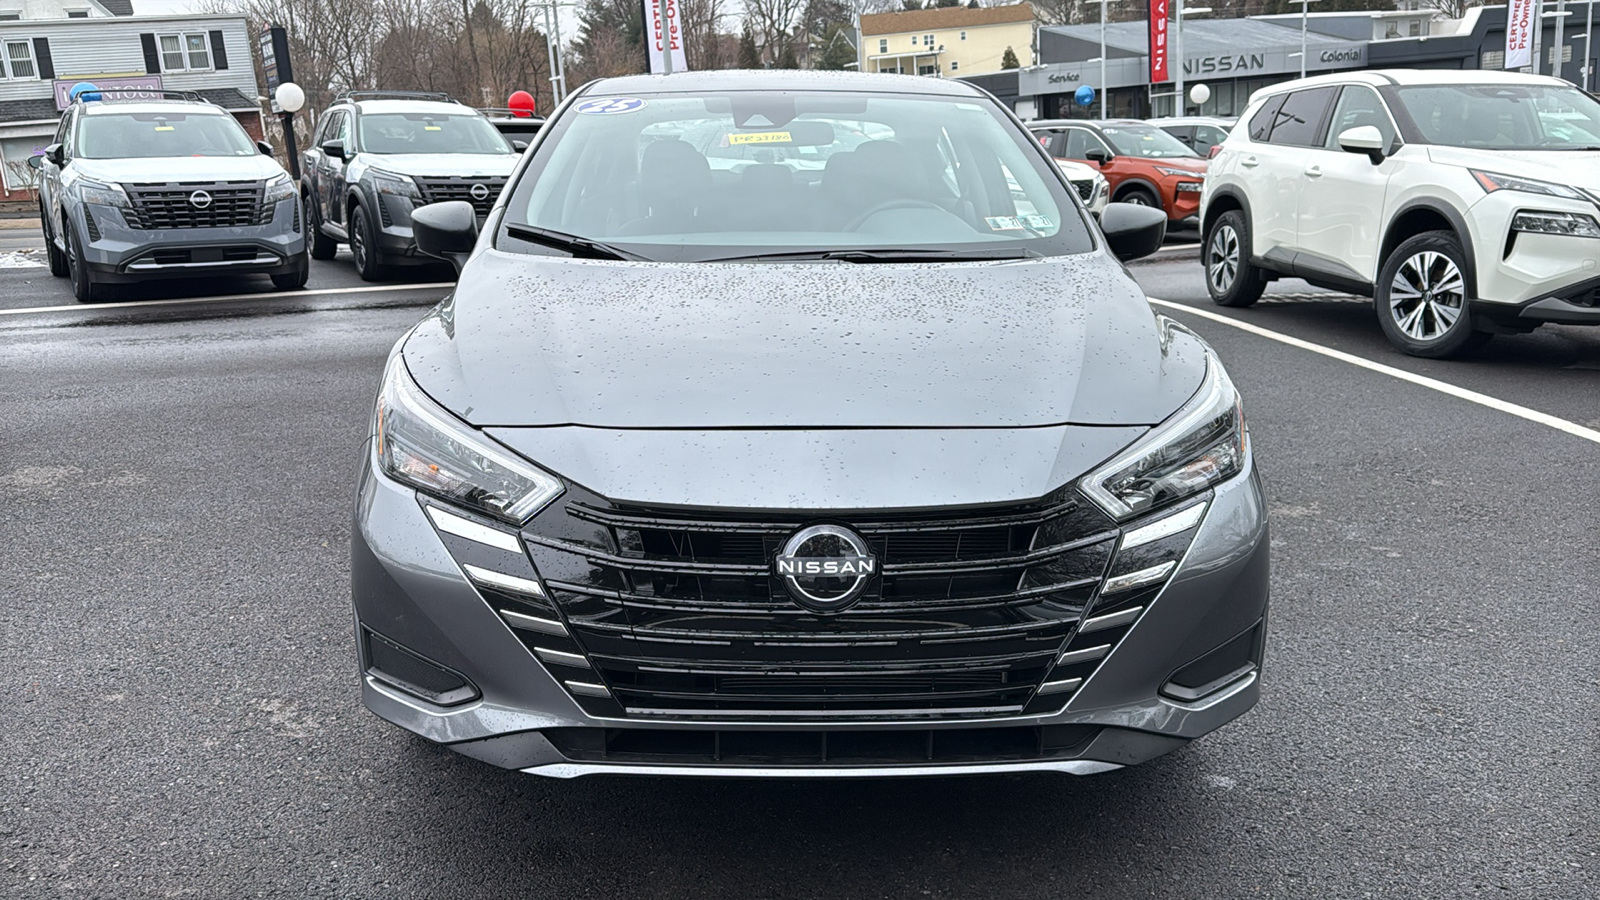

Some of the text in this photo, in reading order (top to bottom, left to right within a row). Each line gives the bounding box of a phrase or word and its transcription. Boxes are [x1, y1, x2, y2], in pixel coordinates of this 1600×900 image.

[1320, 47, 1362, 63] Colonial
[1182, 53, 1264, 75] NISSAN
[1048, 72, 1080, 84] Service
[583, 99, 635, 113] 25
[779, 559, 873, 574] NISSAN
